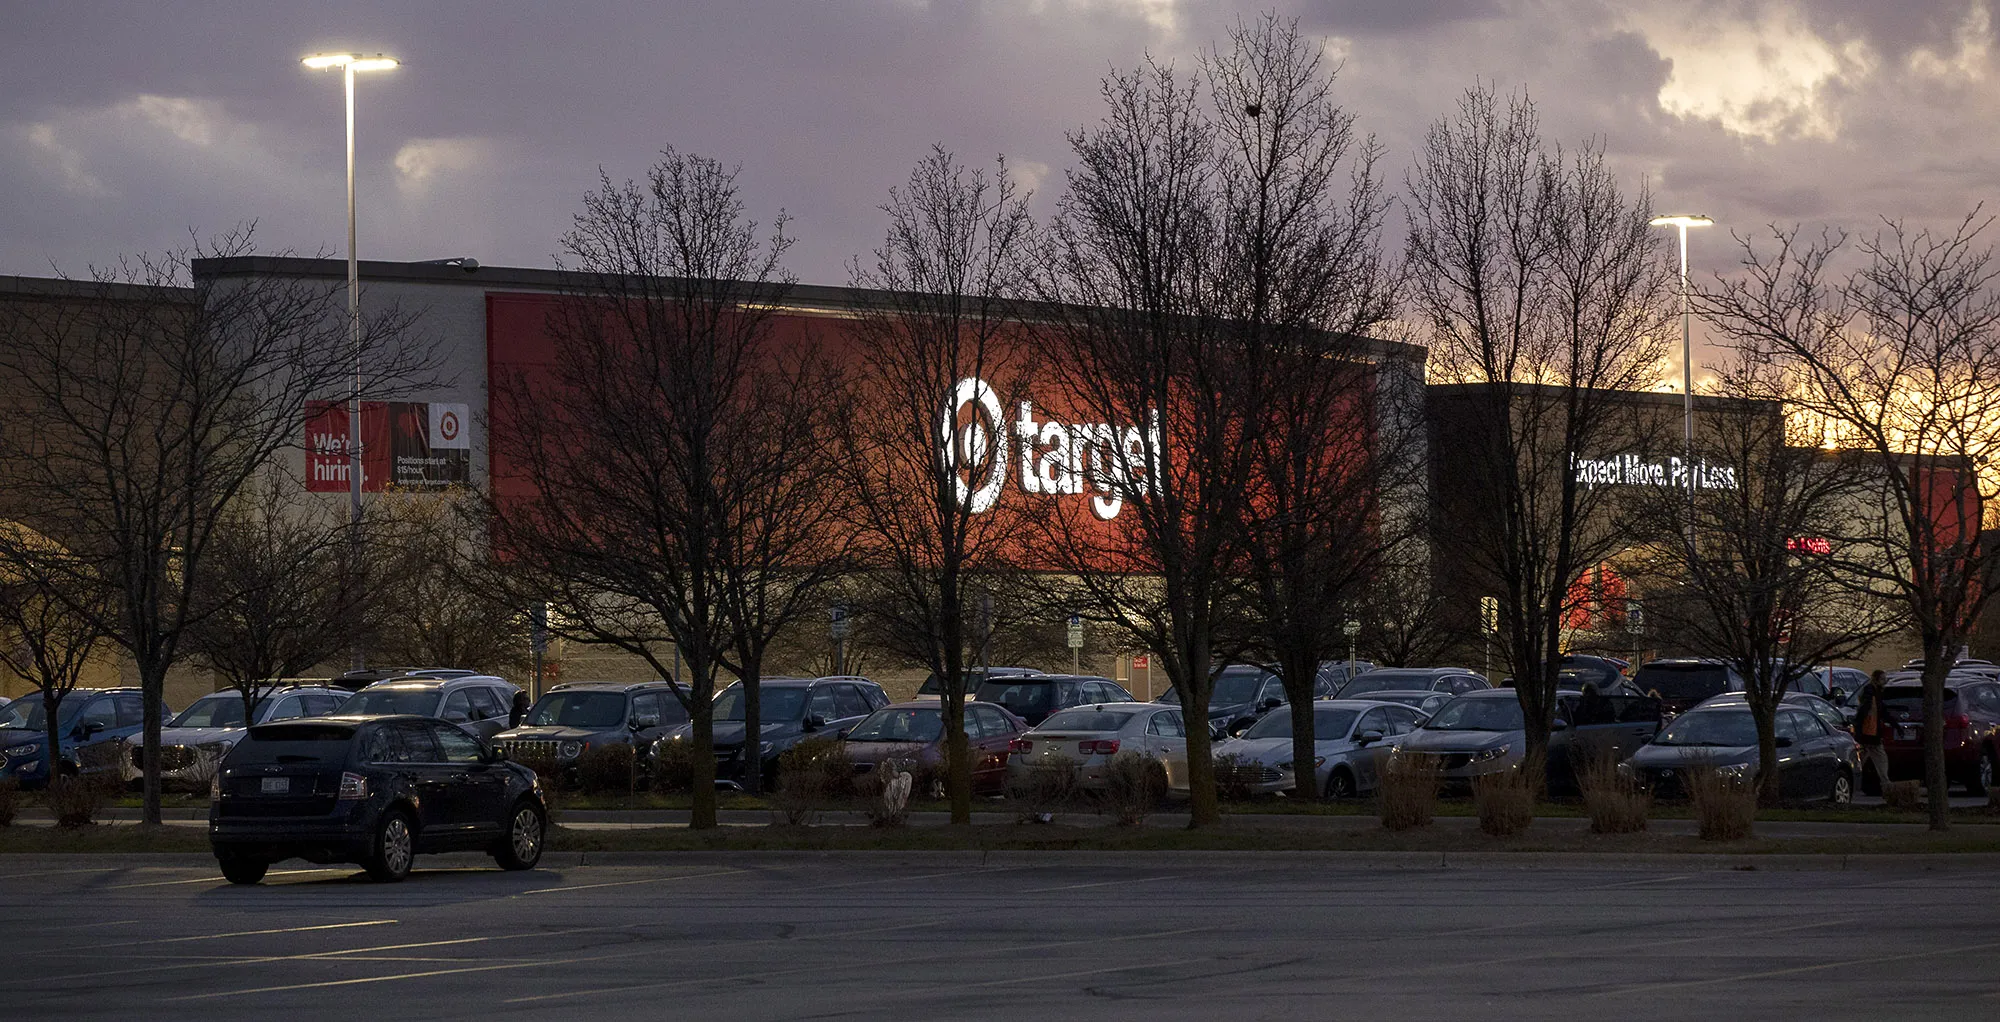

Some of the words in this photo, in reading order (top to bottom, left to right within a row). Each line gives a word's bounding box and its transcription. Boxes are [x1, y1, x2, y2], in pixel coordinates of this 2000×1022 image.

[313, 432, 364, 455] We'r
[397, 455, 424, 465] Positions
[425, 456, 439, 465] start
[439, 457, 447, 465] at
[1015, 401, 1164, 520] target
[1625, 454, 1667, 486] More.
[1701, 457, 1739, 490] Less.
